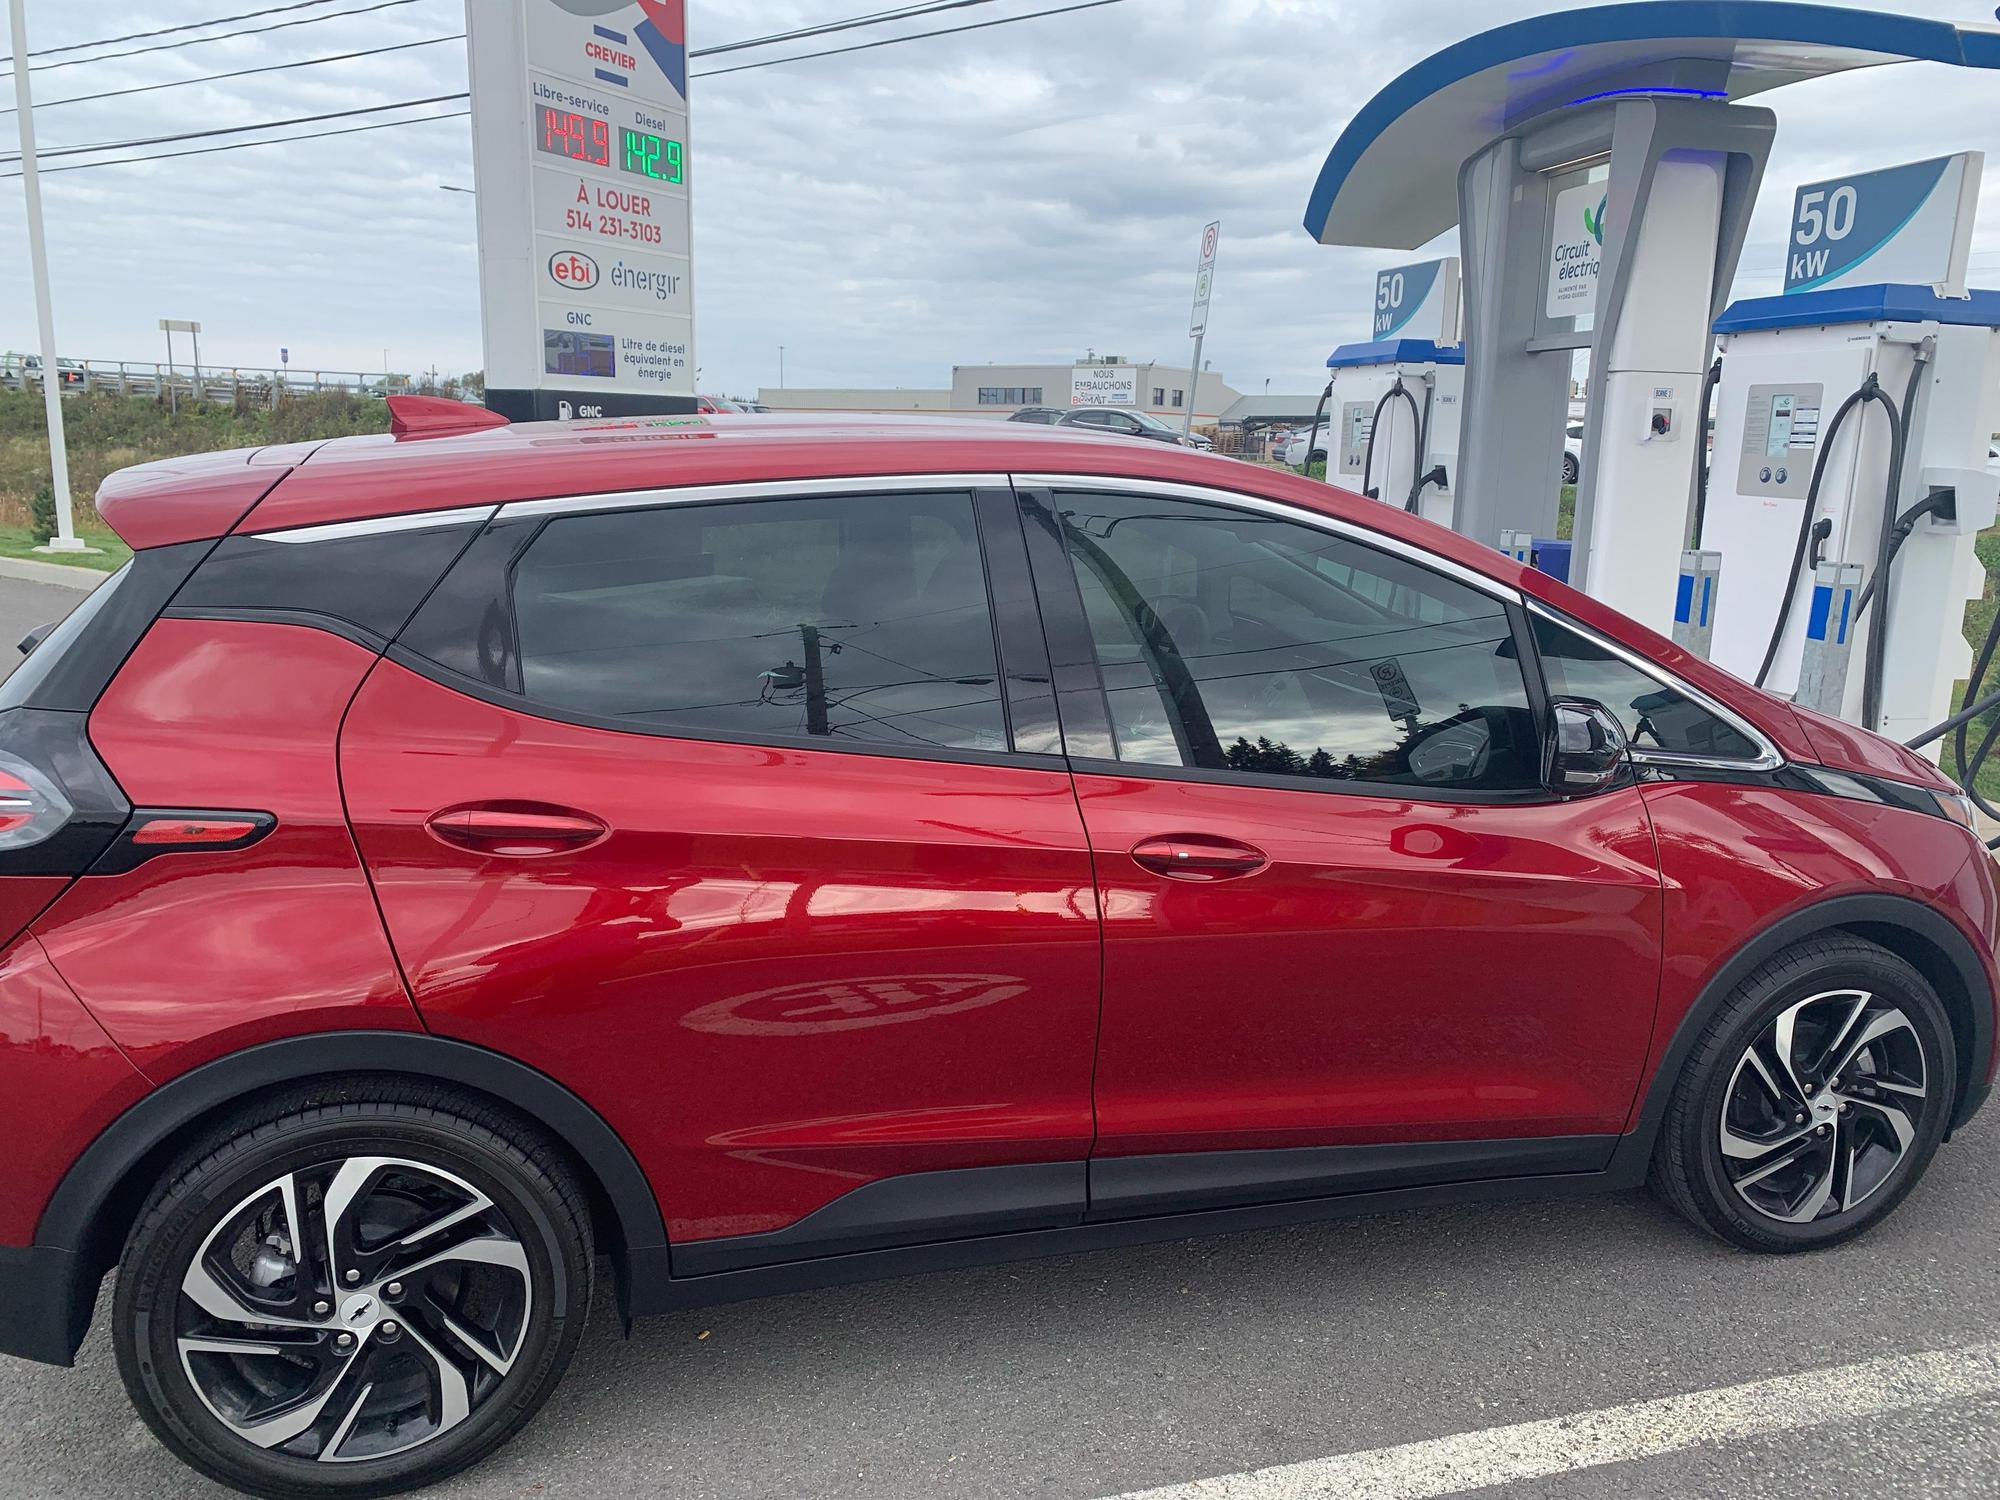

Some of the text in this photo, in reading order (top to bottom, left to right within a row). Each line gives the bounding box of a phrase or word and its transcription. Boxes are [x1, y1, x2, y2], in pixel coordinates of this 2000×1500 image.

[585, 42, 636, 71] CREVIER
[533, 82, 609, 116] Libre-service
[635, 111, 667, 132] Diesel
[545, 110, 609, 166] 149.9
[625, 131, 683, 184] 142.9
[576, 179, 651, 217] À LOUER
[566, 208, 662, 244] 514 231-3103
[1796, 185, 1858, 246] 50
[1554, 240, 1590, 262] Circuit
[555, 255, 592, 284] ebi
[1791, 249, 1830, 280] kW
[1378, 272, 1404, 310] 50
[566, 311, 592, 326] GNC
[1375, 313, 1394, 332] kW
[622, 338, 685, 354] Litre de diesel
[623, 352, 685, 368] équivalent en
[638, 367, 672, 381] énergie
[1074, 381, 1132, 390] EMBAUCHONS
[1093, 369, 1114, 379] NOUS
[578, 405, 603, 418] GNC
